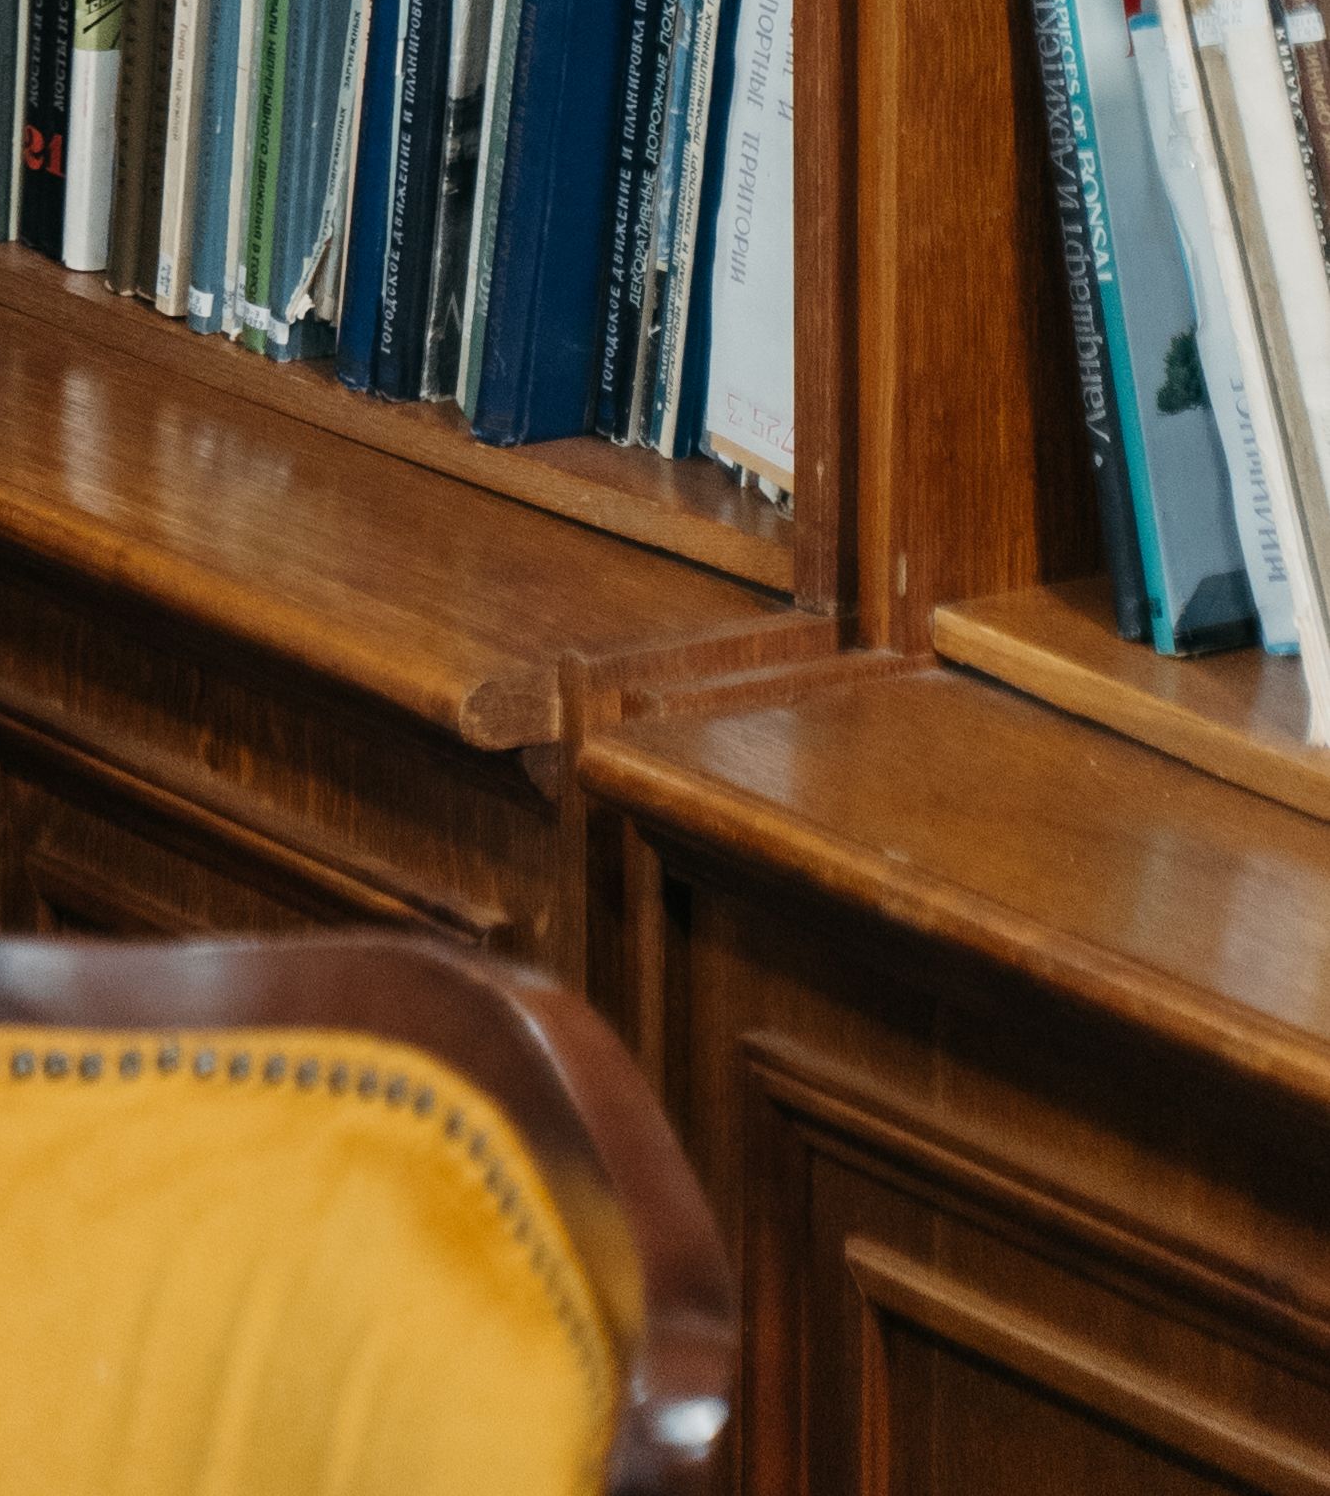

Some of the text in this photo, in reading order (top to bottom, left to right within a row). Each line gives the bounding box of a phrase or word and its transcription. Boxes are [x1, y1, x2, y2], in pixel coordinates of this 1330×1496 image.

[52, 37, 69, 112] МОСТЫ
[260, 37, 278, 155] НЕПРЕРЫВНОГО
[342, 8, 362, 90] ЗАРУБЕЖНЫХ
[692, 11, 716, 147] ПРОМЫШЛЕННЫХ
[1069, 102, 1086, 134] OF
[254, 157, 269, 240] ДВИЖЕНИЯ
[380, 252, 401, 355] ГОРОДСКОЕ
[394, 137, 413, 248] ДВИЖЕНИЕ
[405, 113, 415, 127] И
[601, 17, 646, 393] ГОРОДСКОЕ ДВИЖЕНИЕ И ПЛАНИРОВКА
[629, 168, 658, 308] ДЕКОРАТИВНЫЕ
[645, 50, 669, 164] ДОРОЖНЫЕ
[683, 152, 701, 245] ТРАНСПОРТ
[730, 128, 762, 286] ТЕРРИТОРИИ
[1077, 149, 1114, 284] BONSAI
[676, 261, 692, 301] ПЛАН
[664, 304, 686, 412] ГЕНЕРАЛЬНЫЙ
